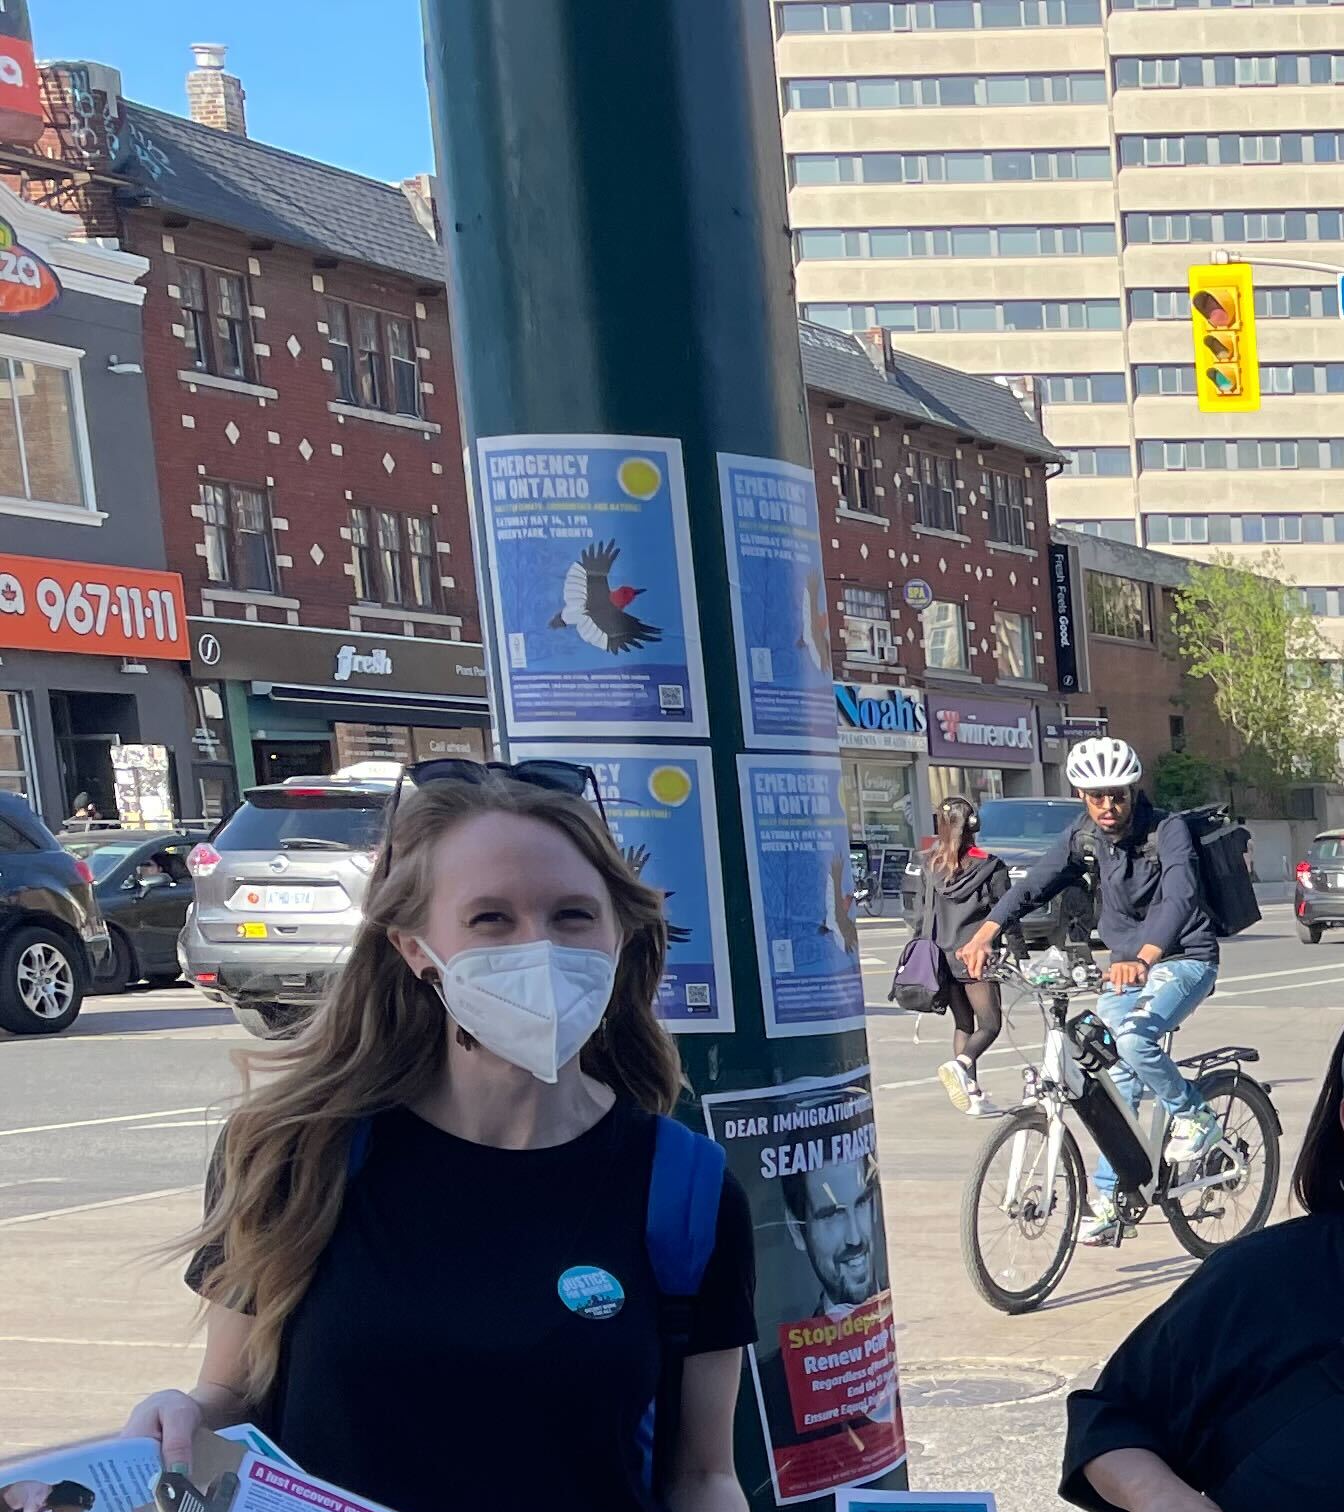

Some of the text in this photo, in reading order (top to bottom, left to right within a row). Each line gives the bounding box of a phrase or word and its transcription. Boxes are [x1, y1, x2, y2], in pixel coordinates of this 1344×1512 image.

[489, 454, 589, 478] EMERGENCY
[492, 477, 590, 500] IN ONTARIO
[1054, 553, 1072, 648] Fresh Feels Good.
[834, 683, 928, 734] Noah's
[724, 1116, 768, 1139] DEAR
[772, 1099, 856, 1133] IMMIGRATION
[759, 1121, 876, 1179] SEAN FRASER
[788, 1322, 838, 1349] Stop
[803, 1344, 862, 1375] Renew
[811, 1367, 867, 1393] Regardless
[847, 1381, 864, 1399] End
[804, 1404, 840, 1426] Ensure
[254, 1466, 264, 1478] A
[265, 1470, 290, 1489] just
